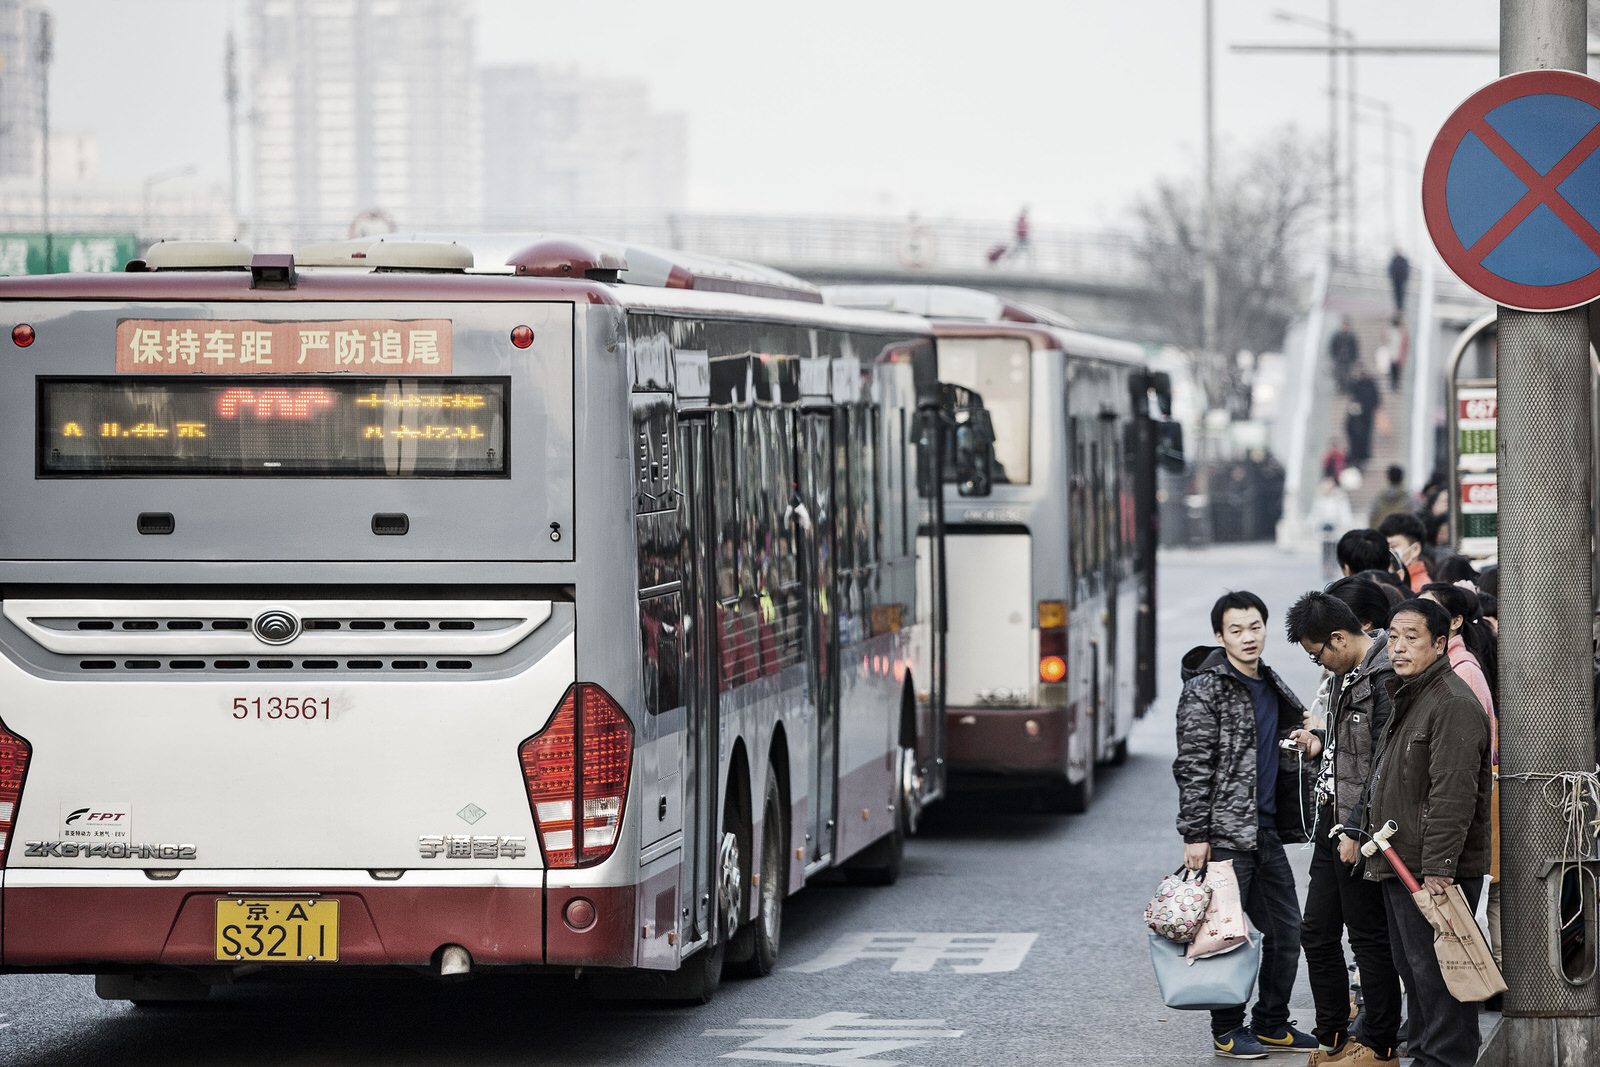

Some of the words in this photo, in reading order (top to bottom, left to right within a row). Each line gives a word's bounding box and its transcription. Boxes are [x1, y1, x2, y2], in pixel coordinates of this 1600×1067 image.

[129, 327, 274, 365] 保持车距
[297, 328, 441, 365] 严防追尾
[1466, 400, 1496, 419] 667
[232, 696, 330, 720] 513561
[87, 812, 126, 821] FPT
[463, 808, 481, 819] LNG
[24, 840, 197, 860] ZK6140HNG2
[418, 834, 527, 859] 宇通客车
[222, 924, 325, 957] S3211
[783, 931, 1039, 974] 用
